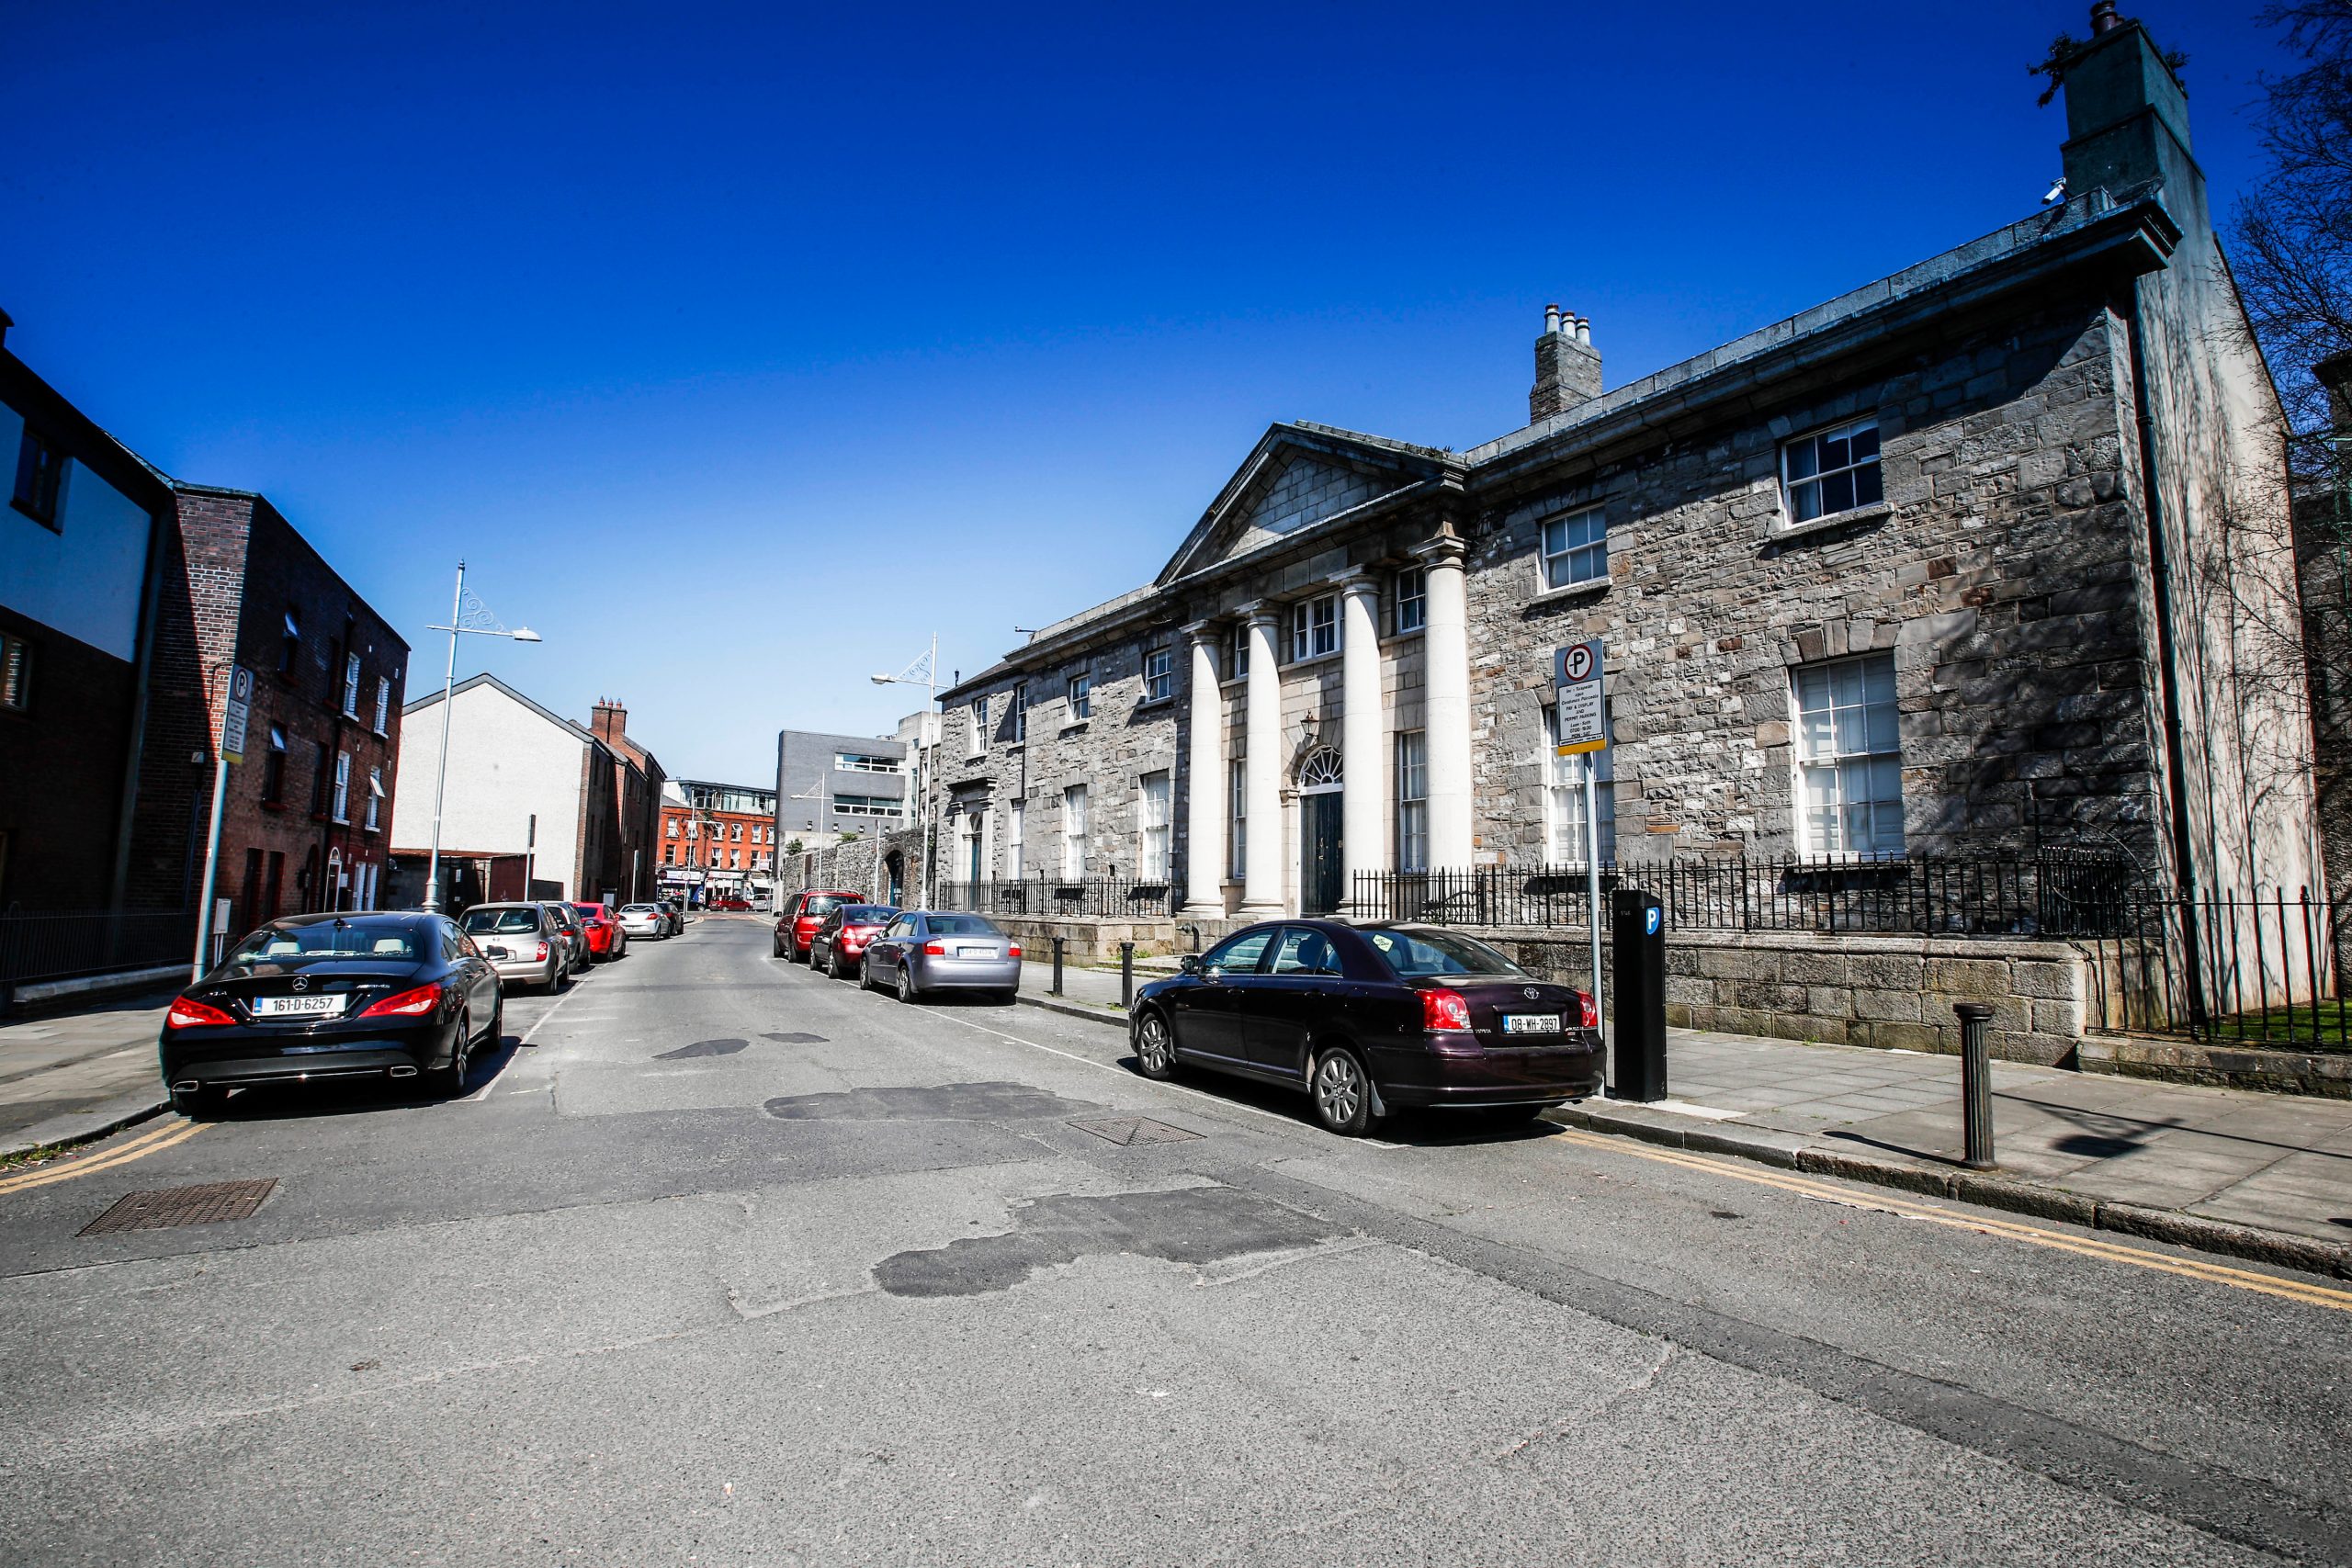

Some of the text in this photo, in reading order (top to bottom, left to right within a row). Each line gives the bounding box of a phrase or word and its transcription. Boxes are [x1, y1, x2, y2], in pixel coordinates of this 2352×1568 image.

[1648, 909, 1657, 930] P
[273, 998, 334, 1011] 161-D-6257
[1511, 1018, 1557, 1031] 08-WH-2897
